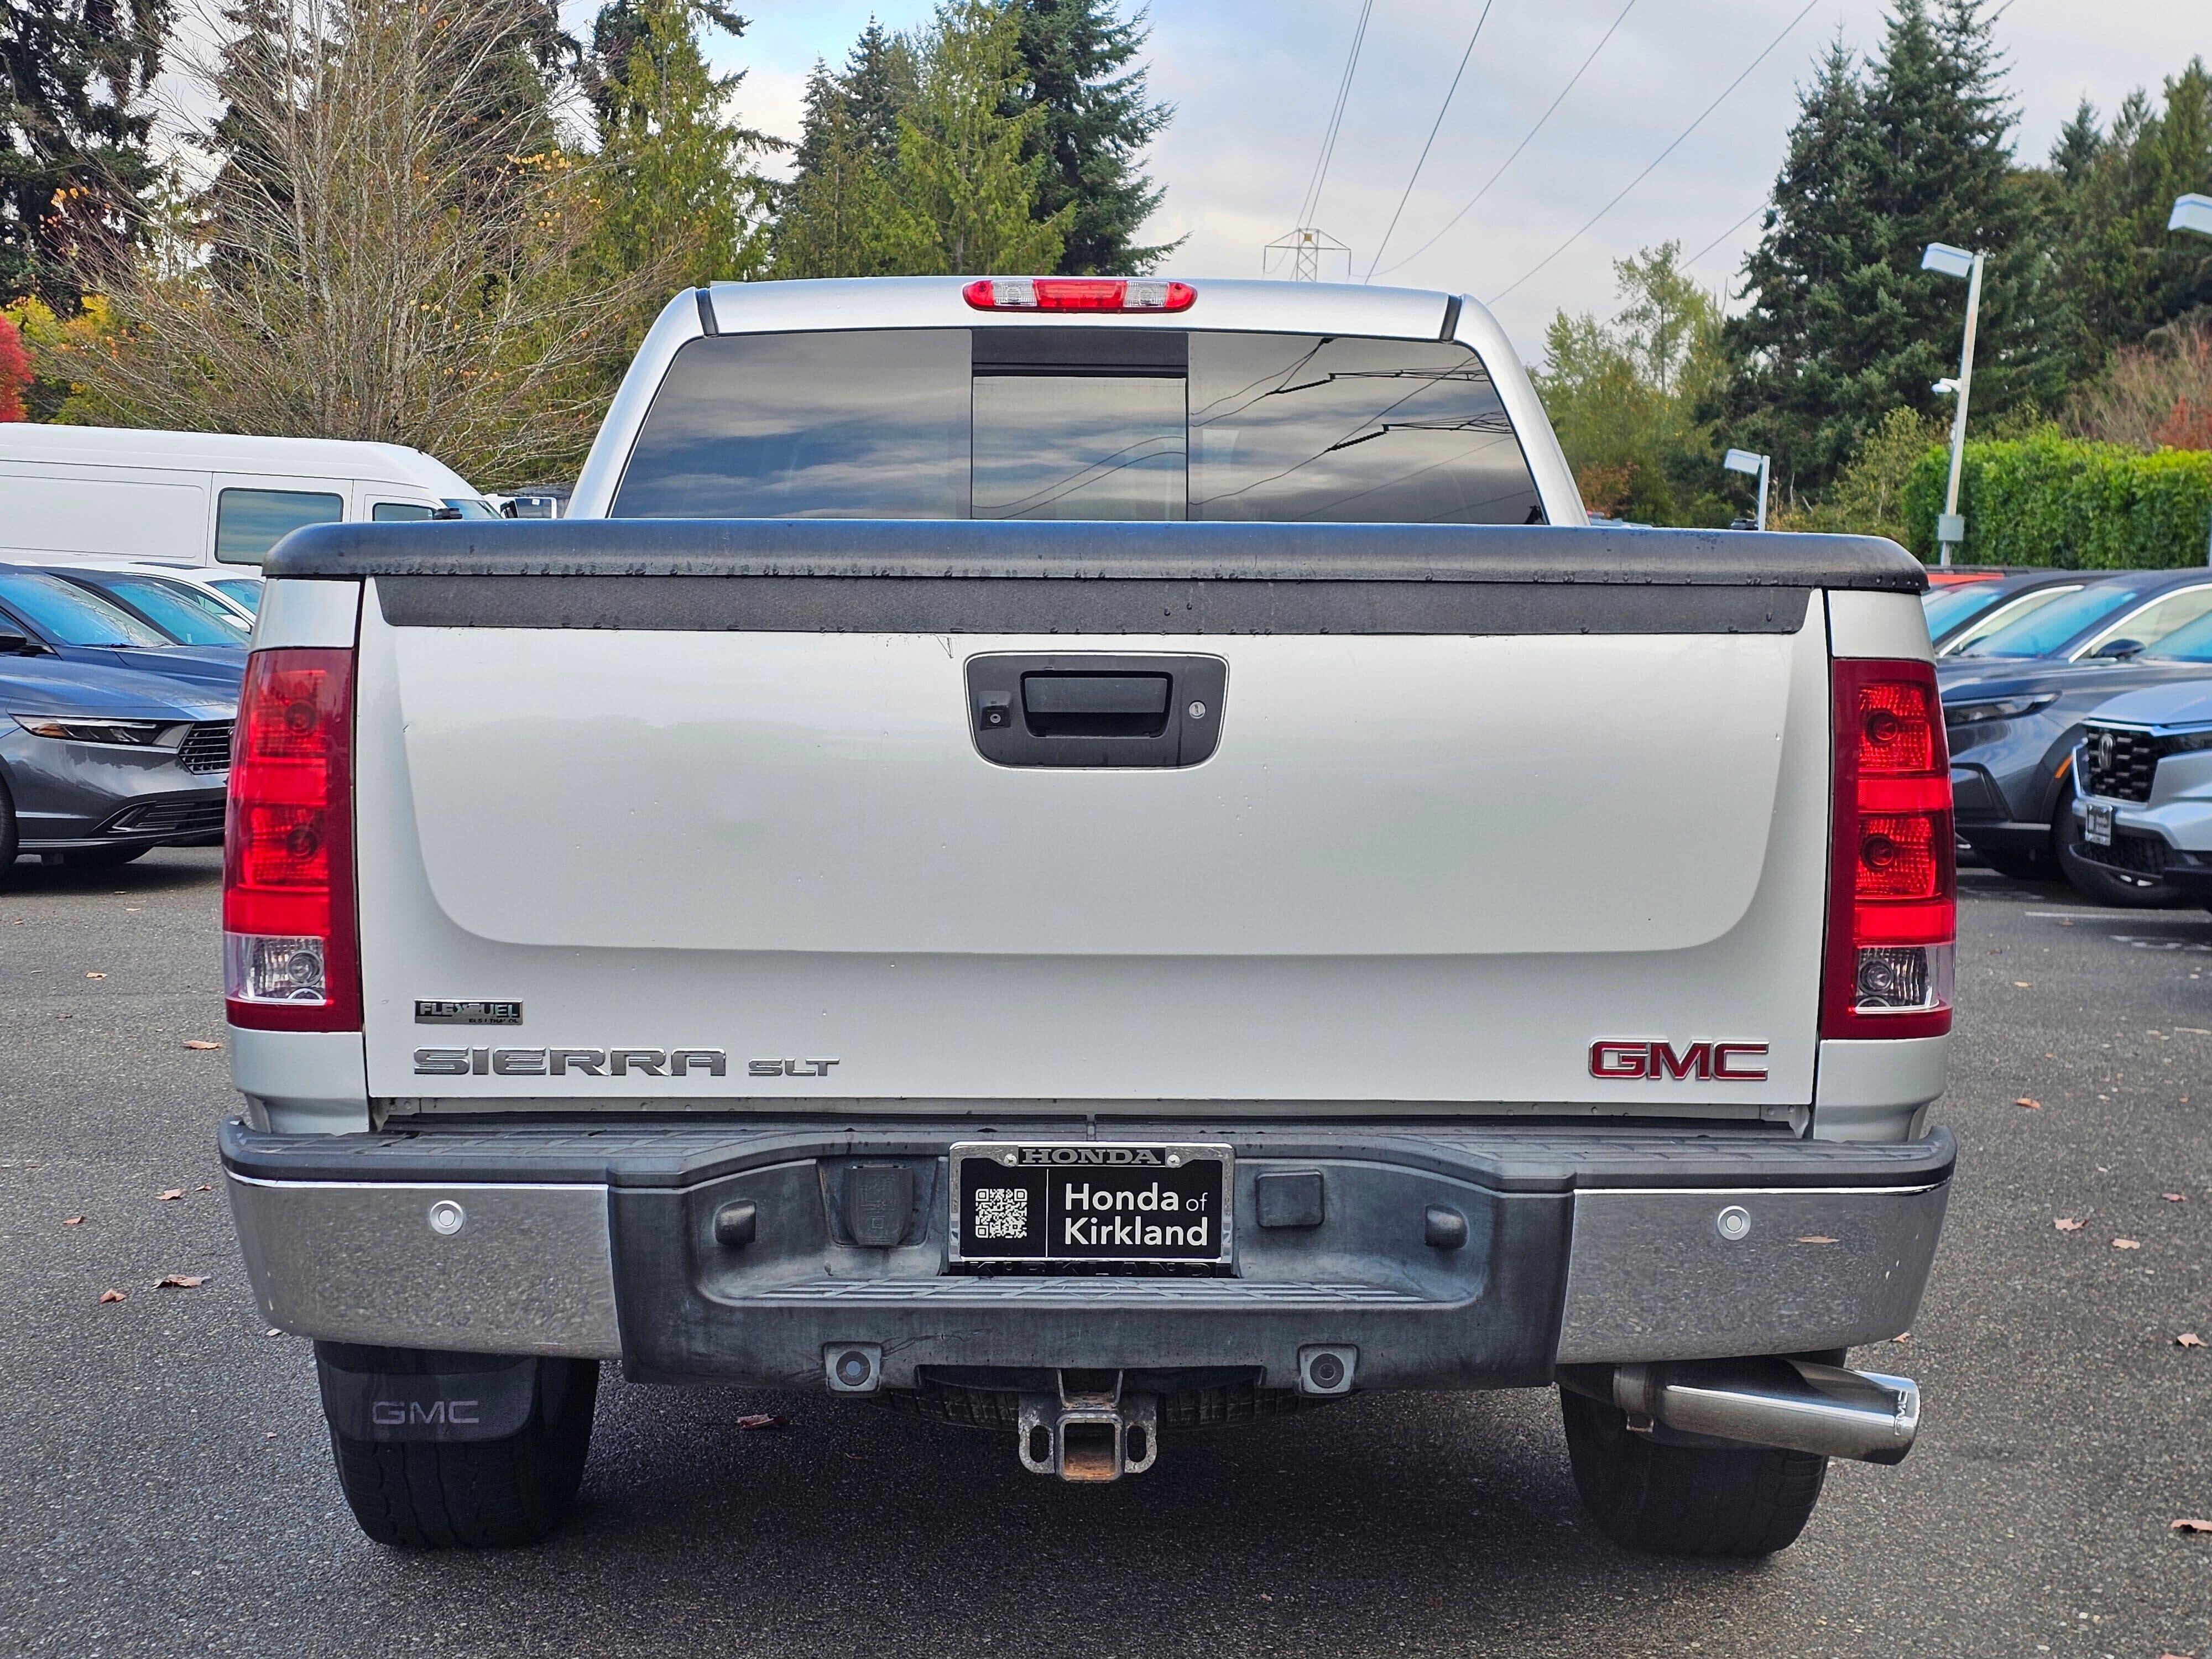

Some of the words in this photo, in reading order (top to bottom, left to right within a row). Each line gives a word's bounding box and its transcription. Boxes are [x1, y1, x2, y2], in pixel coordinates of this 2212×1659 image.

[413, 1046, 727, 1077] SIERRA
[748, 1058, 840, 1077] SLT
[1588, 1037, 1770, 1081] GMC
[1022, 1149, 1161, 1164] HONDA
[1065, 1182, 1179, 1211] Honda
[1186, 1192, 1208, 1212] of
[1065, 1216, 1208, 1246] Kirkland
[372, 1400, 479, 1425] GMC
